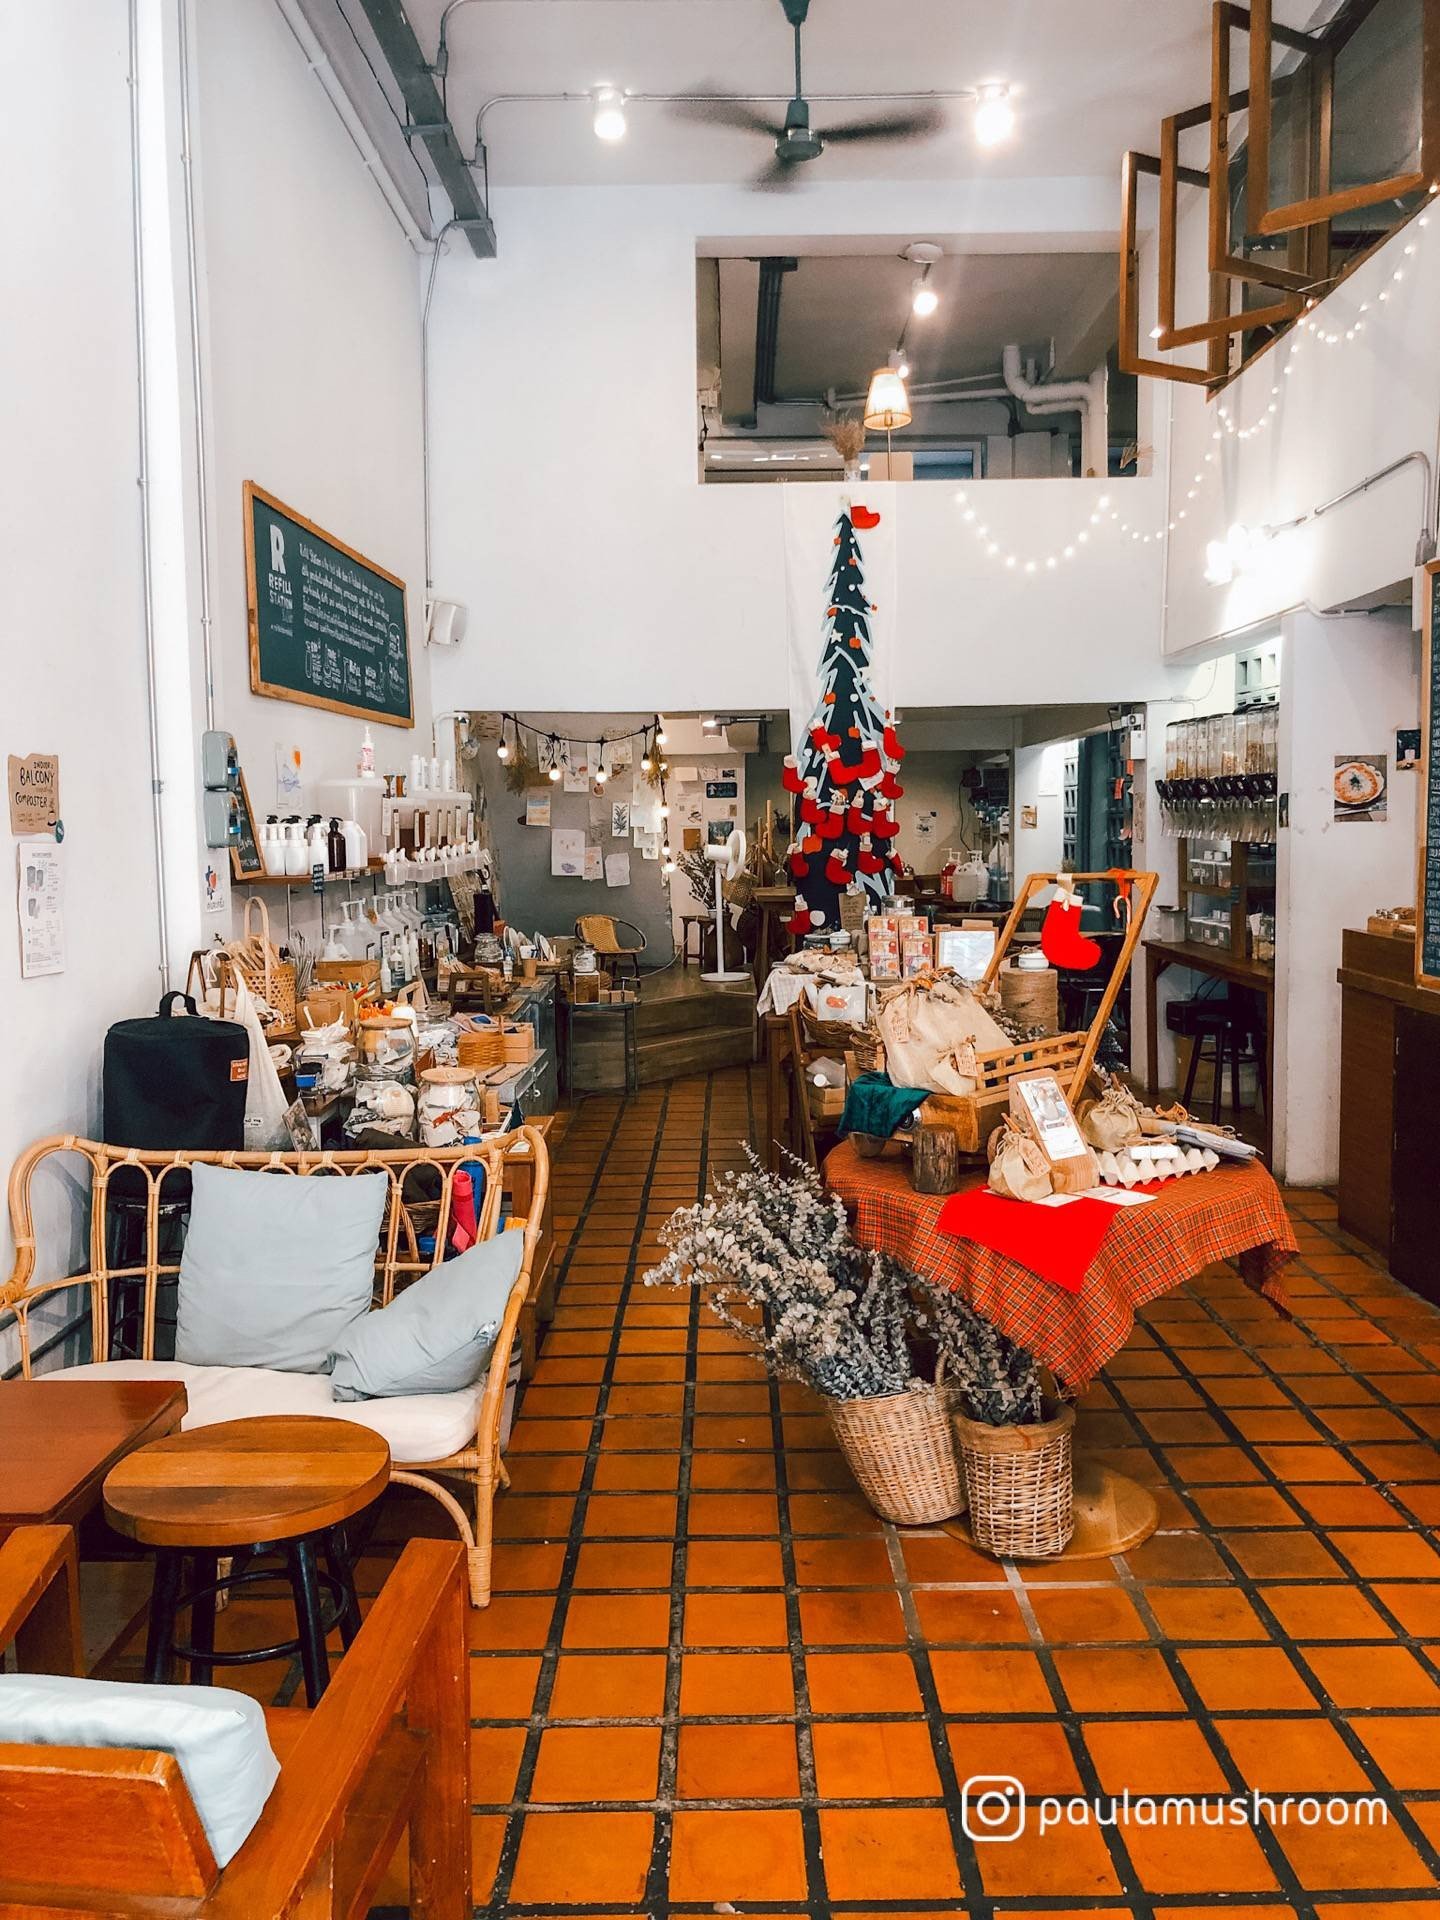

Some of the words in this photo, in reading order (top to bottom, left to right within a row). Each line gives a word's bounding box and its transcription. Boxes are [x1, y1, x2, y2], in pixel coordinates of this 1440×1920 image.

[269, 523, 287, 575] R
[268, 572, 293, 595] REFILL
[269, 590, 293, 610] STATION
[20, 767, 55, 787] BALCONY
